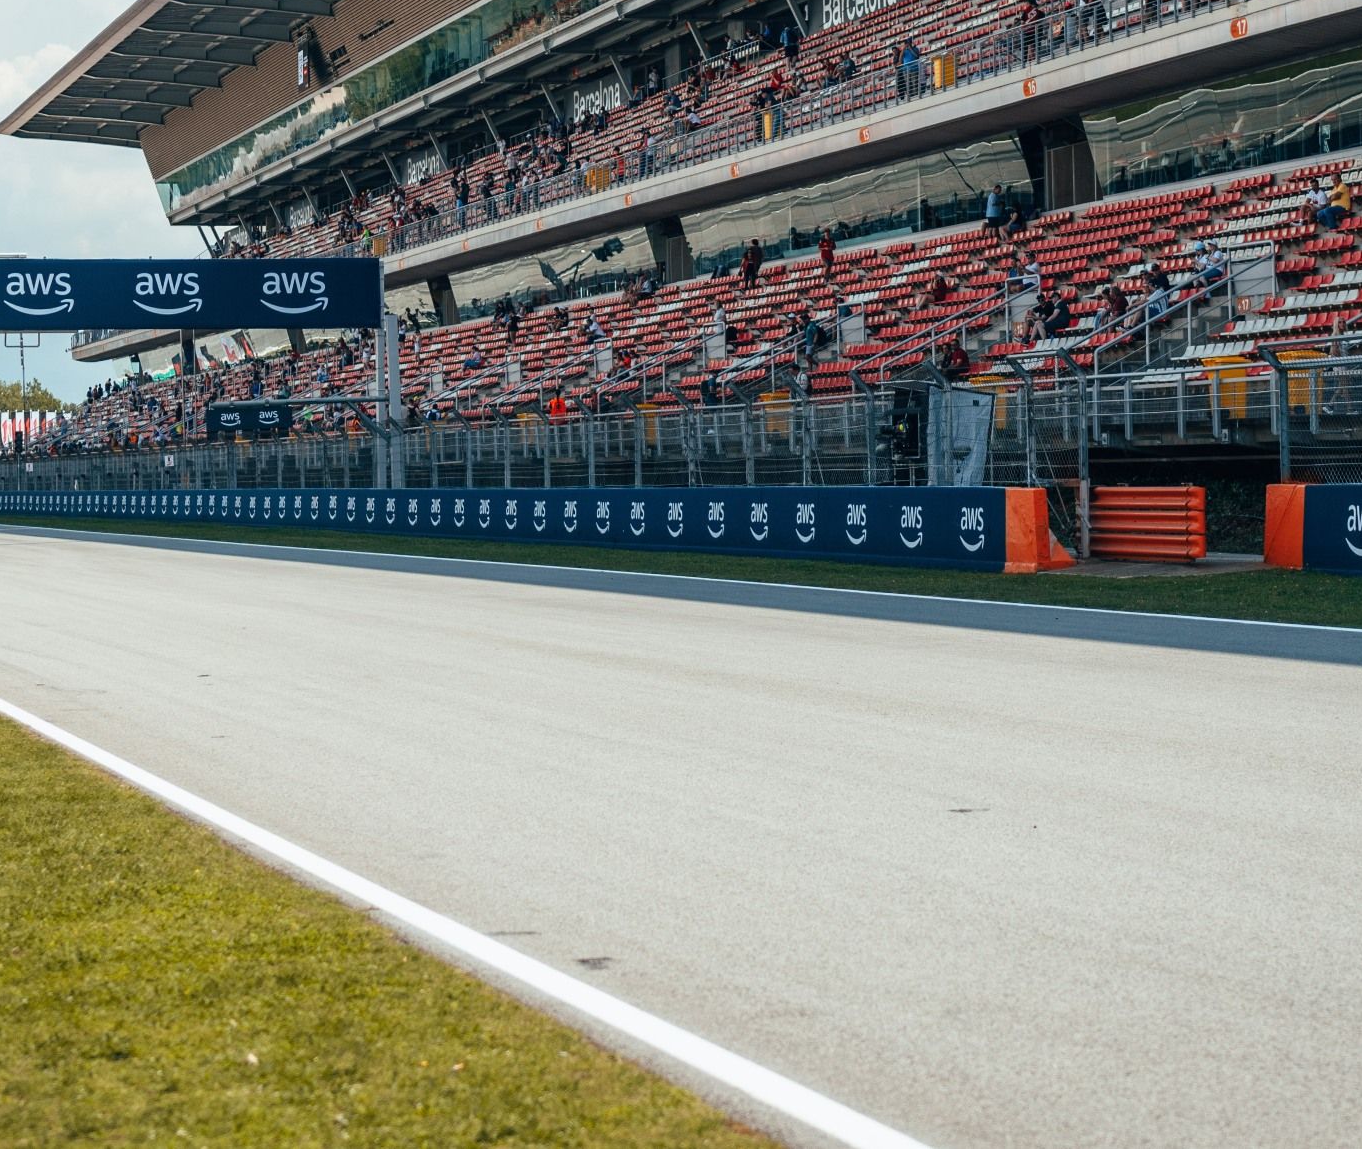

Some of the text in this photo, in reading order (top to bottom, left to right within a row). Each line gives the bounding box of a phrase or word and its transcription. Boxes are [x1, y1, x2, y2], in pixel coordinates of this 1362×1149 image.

[1236, 20, 1246, 35] 17
[1028, 80, 1036, 94] 16
[7, 273, 71, 295] aws
[136, 273, 199, 295] aws
[263, 272, 325, 294] aws
[506, 500, 517, 515] aws
[534, 501, 545, 517] aws
[565, 501, 577, 517] aws
[597, 502, 609, 519] aws
[631, 502, 644, 520] aws
[668, 502, 683, 521] aws
[709, 502, 724, 521] aws
[751, 503, 767, 523] aws
[797, 504, 814, 524] aws
[847, 504, 866, 525] aws
[901, 506, 922, 528] aws
[961, 507, 983, 531] aws
